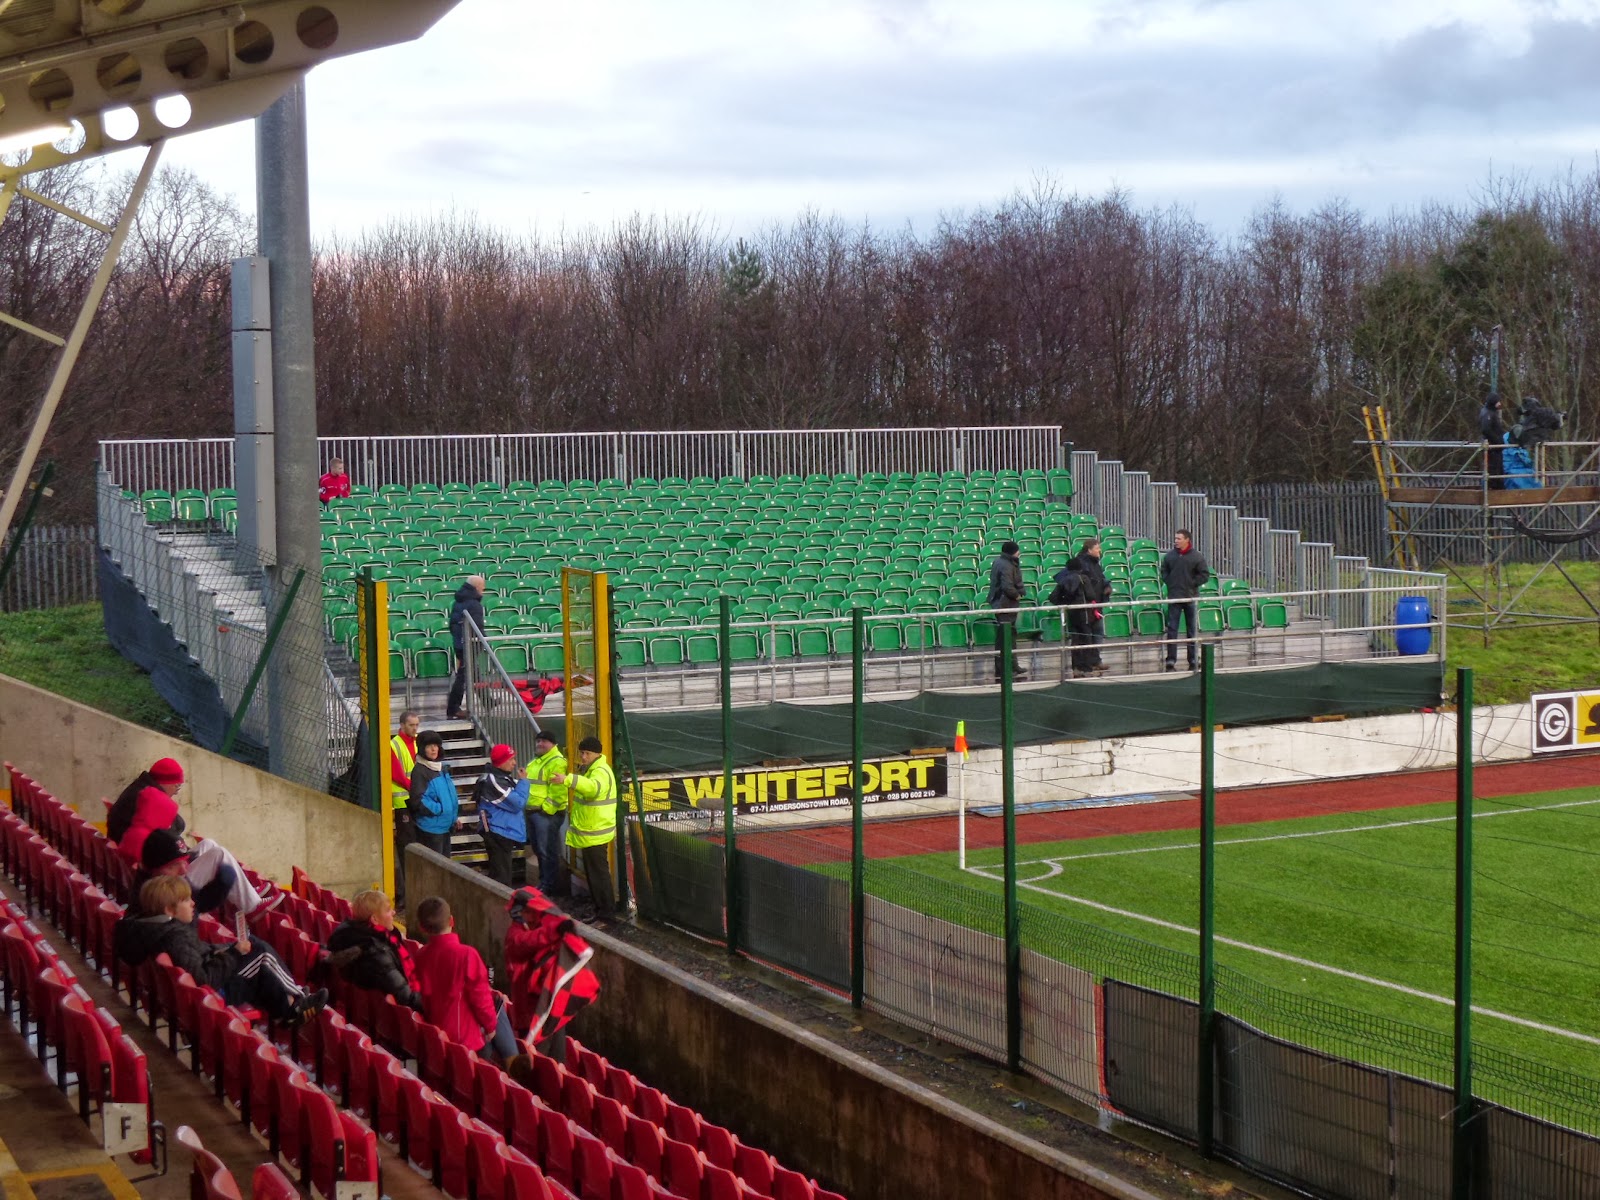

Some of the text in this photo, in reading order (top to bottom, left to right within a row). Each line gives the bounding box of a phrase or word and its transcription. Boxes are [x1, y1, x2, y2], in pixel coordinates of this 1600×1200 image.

[682, 759, 935, 808] WHITEFORT
[668, 810, 711, 820] FUNCTION
[769, 799, 829, 812] ANDERSONSTOWN
[887, 792, 900, 801] 028
[900, 791, 909, 799] 90
[120, 1115, 131, 1140] F
